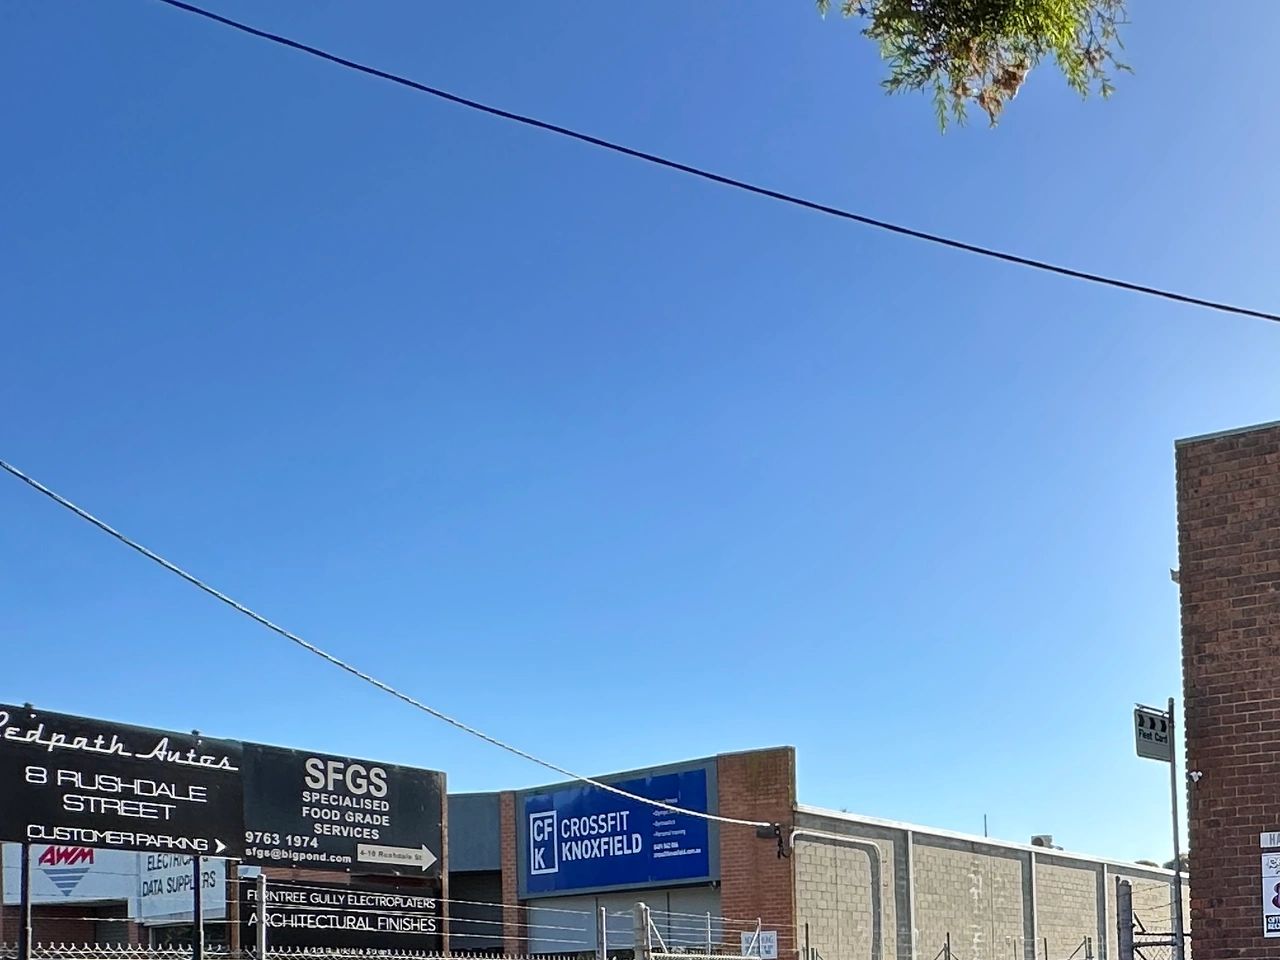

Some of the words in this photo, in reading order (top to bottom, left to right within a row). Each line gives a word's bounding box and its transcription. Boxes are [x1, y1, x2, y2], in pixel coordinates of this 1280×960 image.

[135, 737, 239, 771] Autos
[25, 766, 47, 784] 8
[57, 769, 207, 803] RUSHDALE
[304, 757, 388, 798] SFGS
[63, 794, 176, 820] STREET
[302, 791, 389, 812] SPECIALISED
[302, 806, 340, 821] FOOD
[344, 811, 390, 826] GRADE
[561, 810, 630, 838] CROSSFIT
[27, 824, 134, 845] CUSTOMER
[136, 833, 208, 851] PARKING
[245, 831, 280, 845] 9763
[285, 834, 319, 848] 1974
[314, 823, 380, 840] SERVICES
[533, 818, 553, 842] CF
[38, 845, 94, 866] AWM
[245, 848, 352, 864] sfgs@bigpond.com
[534, 847, 546, 869] K
[561, 833, 642, 861] KNOXFIELD
[147, 853, 196, 871] ELECTRICA
[142, 879, 163, 897] DATA
[167, 870, 216, 893] SUPPLRS
[247, 889, 307, 903] FRNTREE
[310, 893, 345, 905] GULLY
[347, 894, 436, 909] ELECTROPLATERS
[248, 913, 375, 930] ARCHITECTURAL
[378, 916, 436, 932] FINISHES
